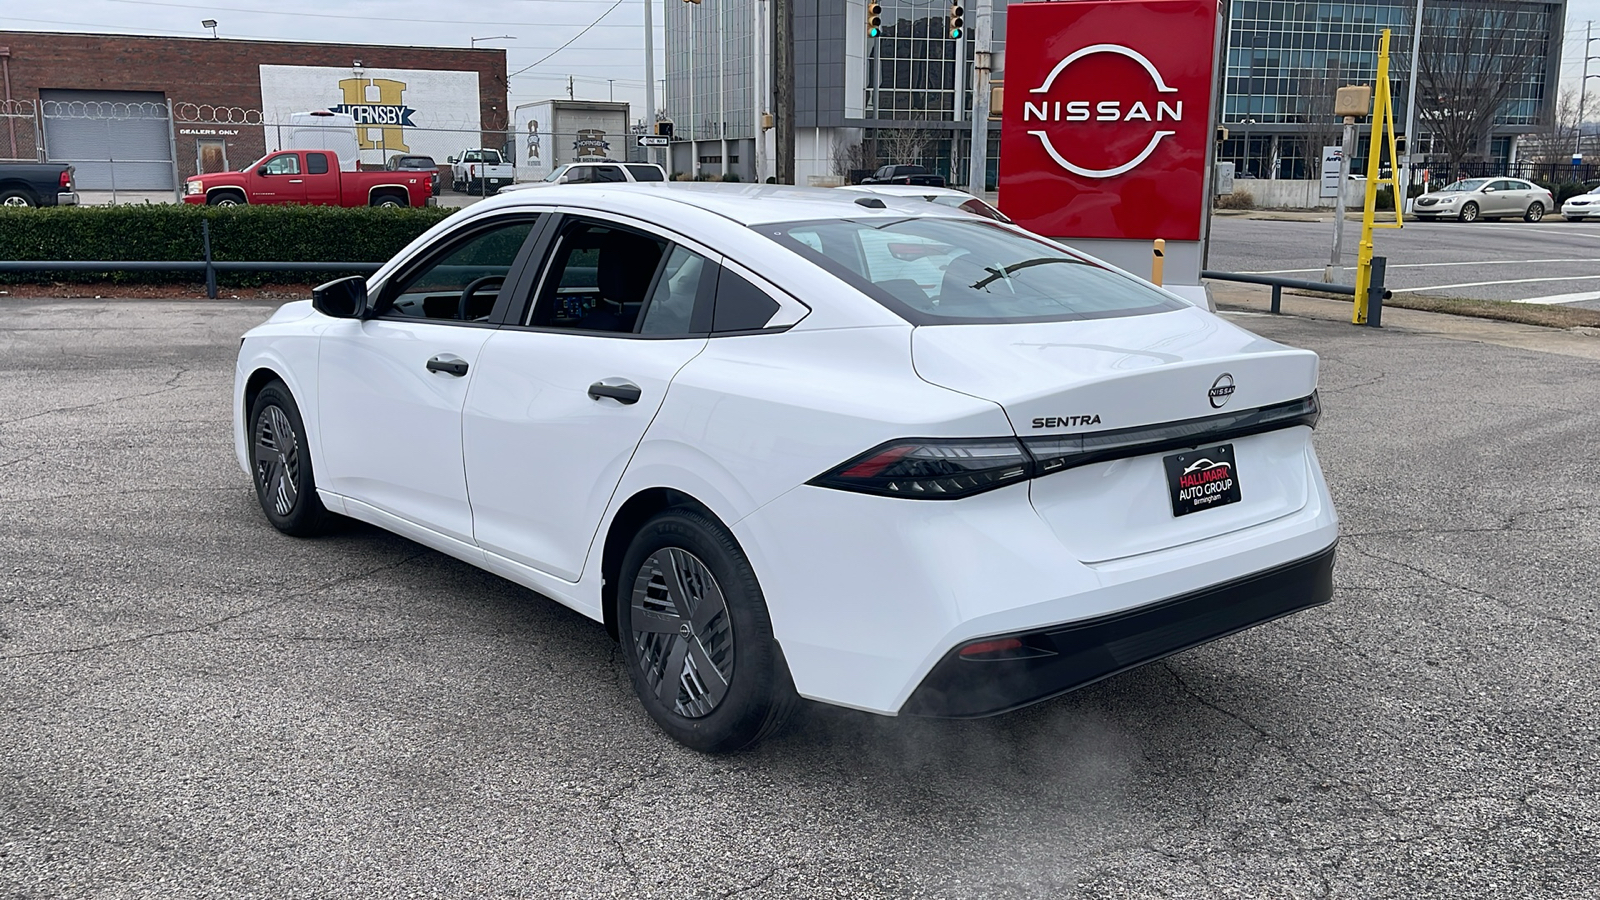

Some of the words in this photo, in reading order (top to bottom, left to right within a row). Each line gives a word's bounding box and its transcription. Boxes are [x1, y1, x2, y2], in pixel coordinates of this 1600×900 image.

[1024, 101, 1182, 121] NISSAN
[1209, 386, 1235, 397] NISSAN
[1032, 414, 1101, 428] SENTRA
[1180, 467, 1229, 488] HALLMARK
[1180, 486, 1203, 501] AUTO
[1204, 479, 1232, 495] GROUP
[1194, 494, 1221, 505] Birmingham
